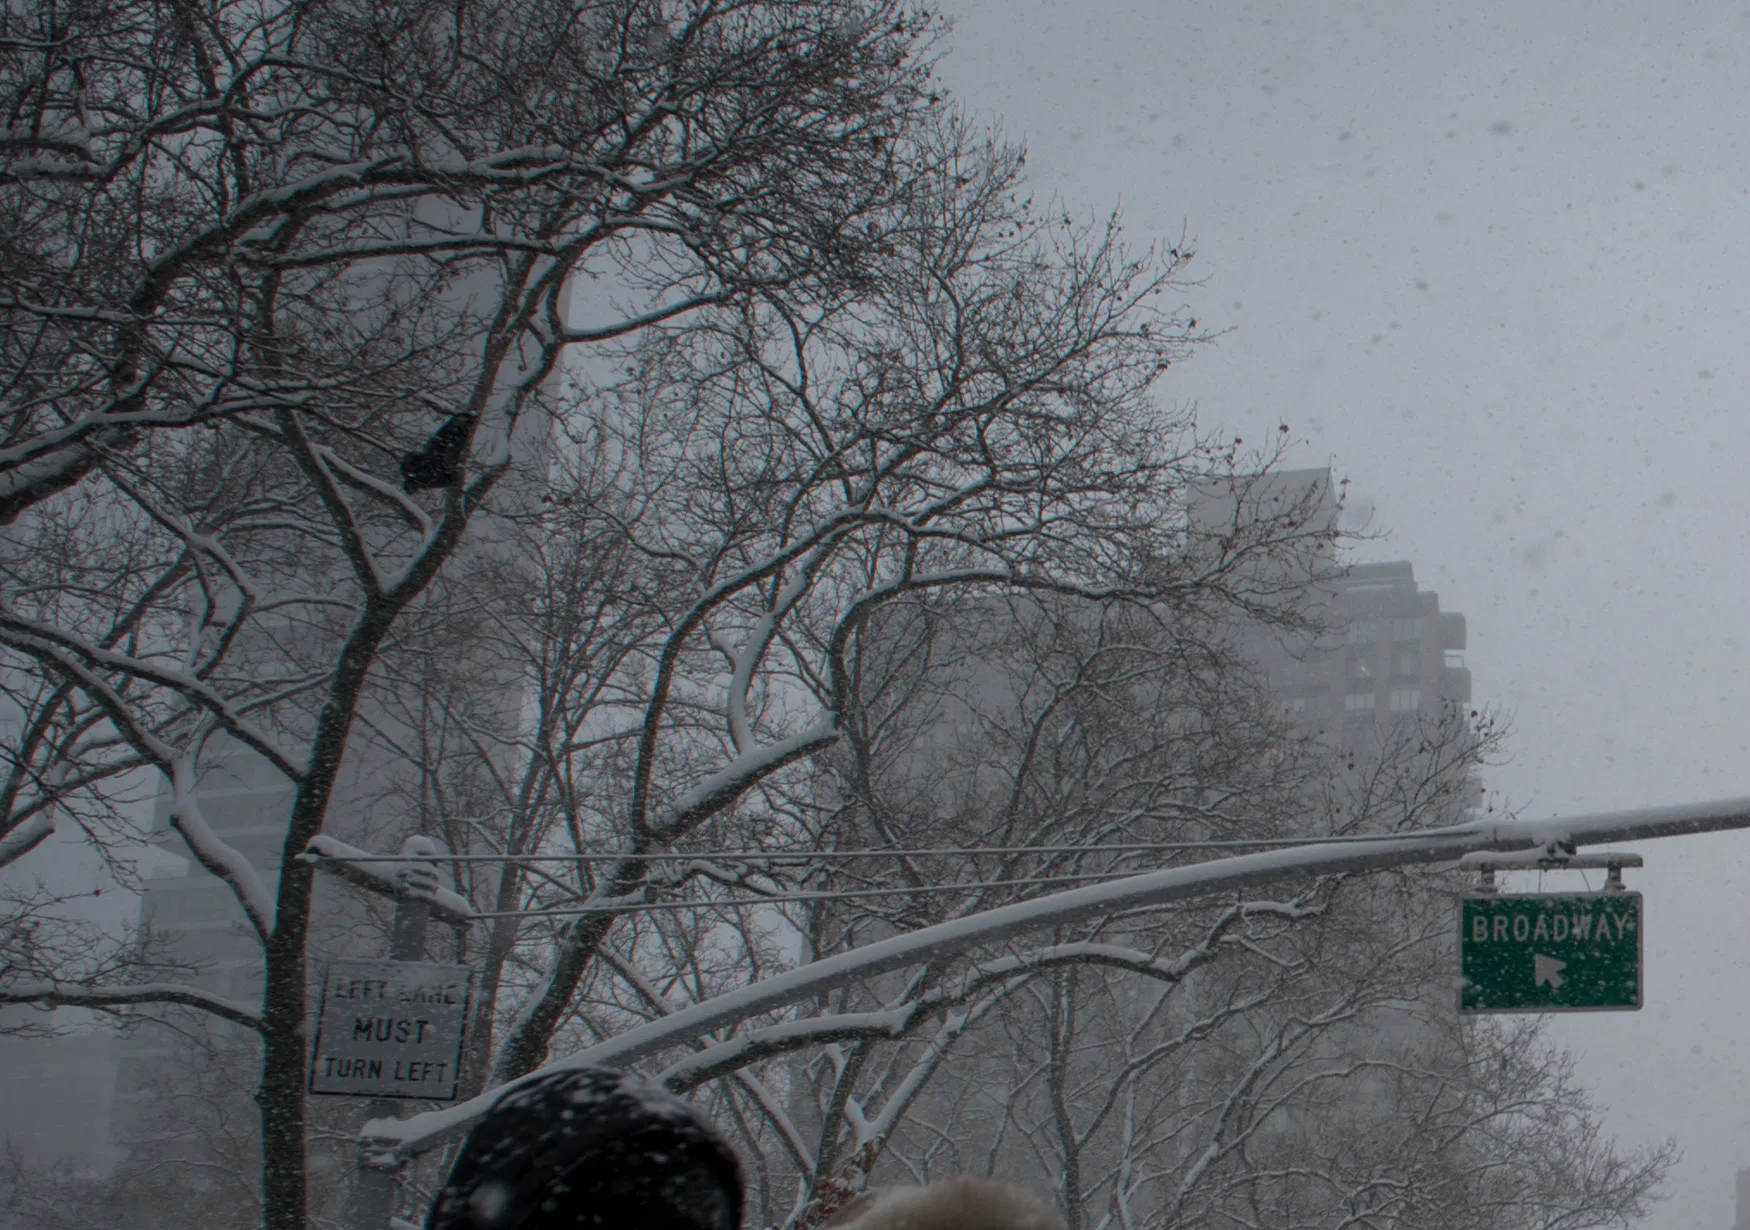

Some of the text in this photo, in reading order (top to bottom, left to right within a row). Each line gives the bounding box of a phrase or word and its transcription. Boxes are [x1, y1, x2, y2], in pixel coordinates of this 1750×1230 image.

[1472, 912, 1627, 943] BROADWAY
[335, 979, 388, 1000] LEFT
[353, 1017, 428, 1044] MUST
[325, 1056, 448, 1083] TURN LEFT
